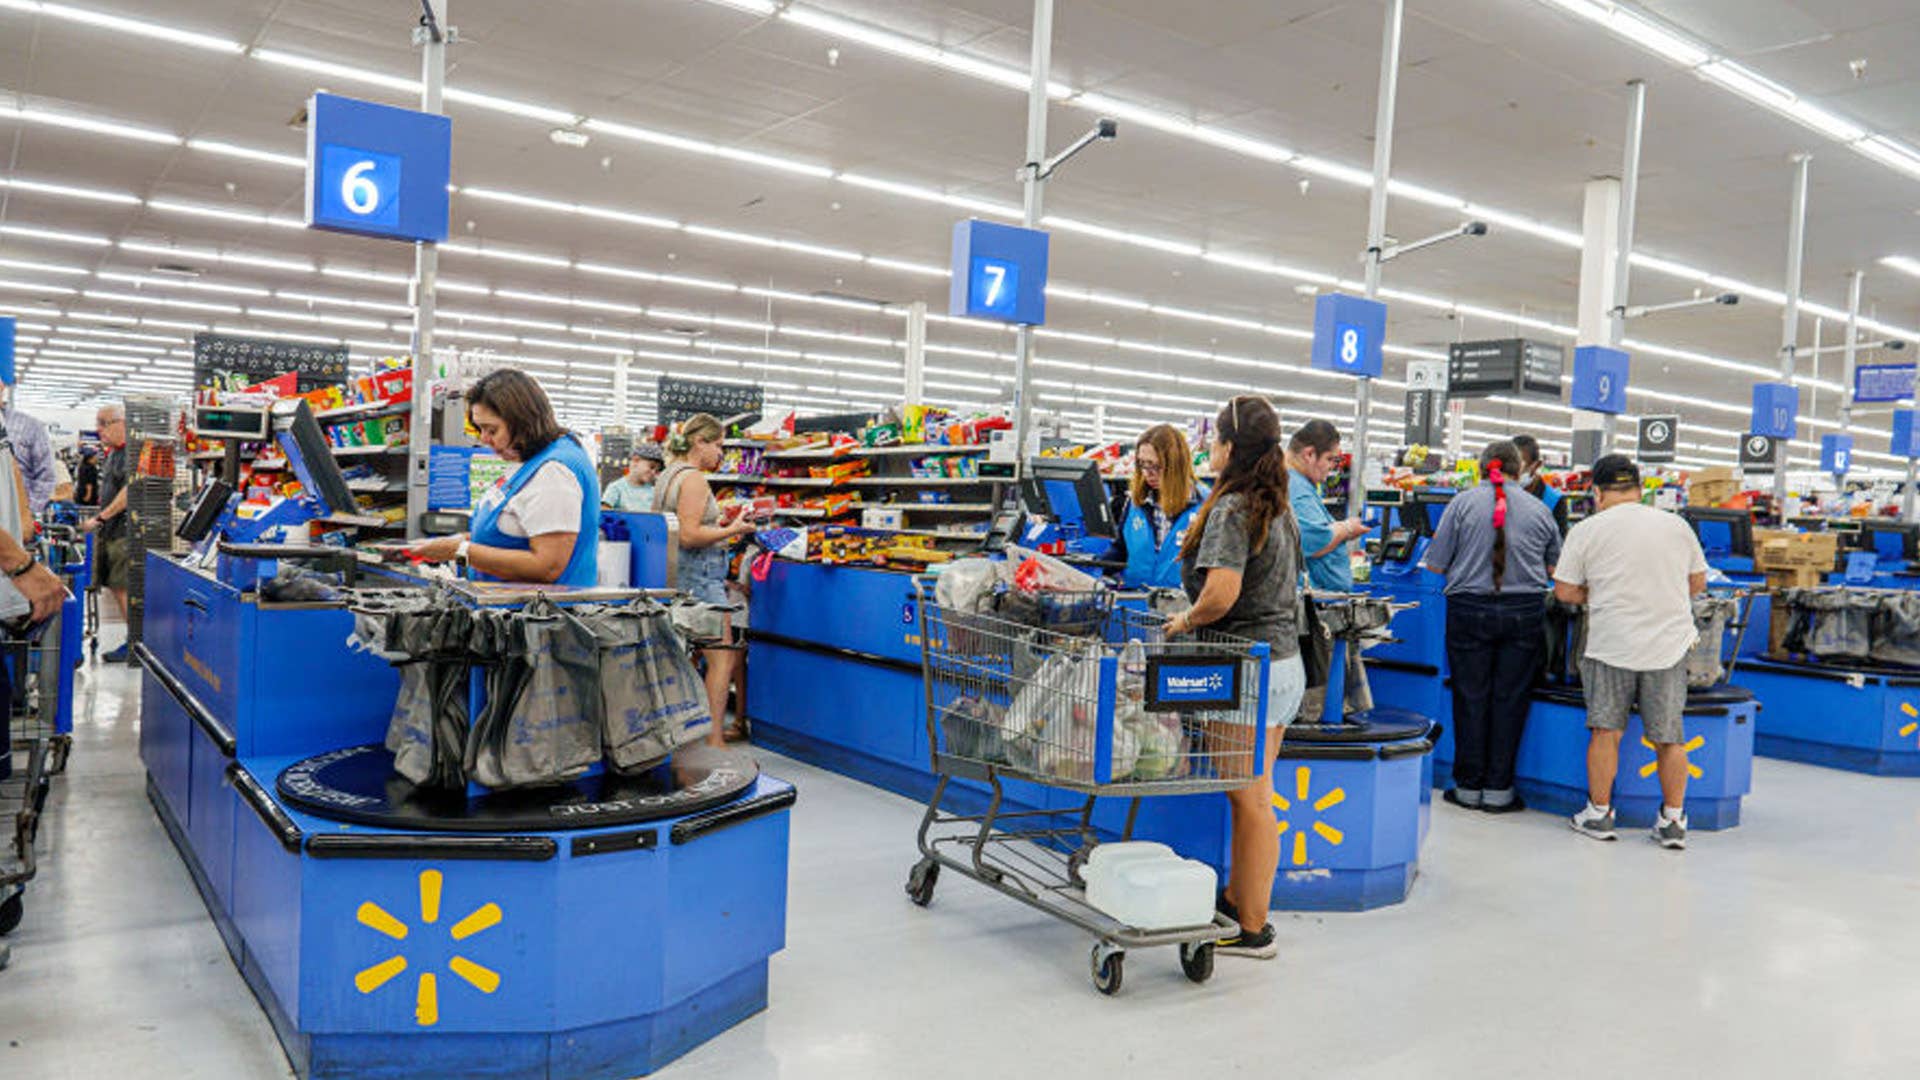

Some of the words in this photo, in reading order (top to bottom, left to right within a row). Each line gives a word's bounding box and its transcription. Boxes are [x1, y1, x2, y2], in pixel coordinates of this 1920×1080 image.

[341, 160, 379, 215] 6
[984, 265, 1006, 307] 7
[1342, 329, 1358, 364] 8
[1599, 375, 1610, 403] 9
[1774, 407, 1788, 431] 10
[1167, 677, 1208, 687] Walmart
